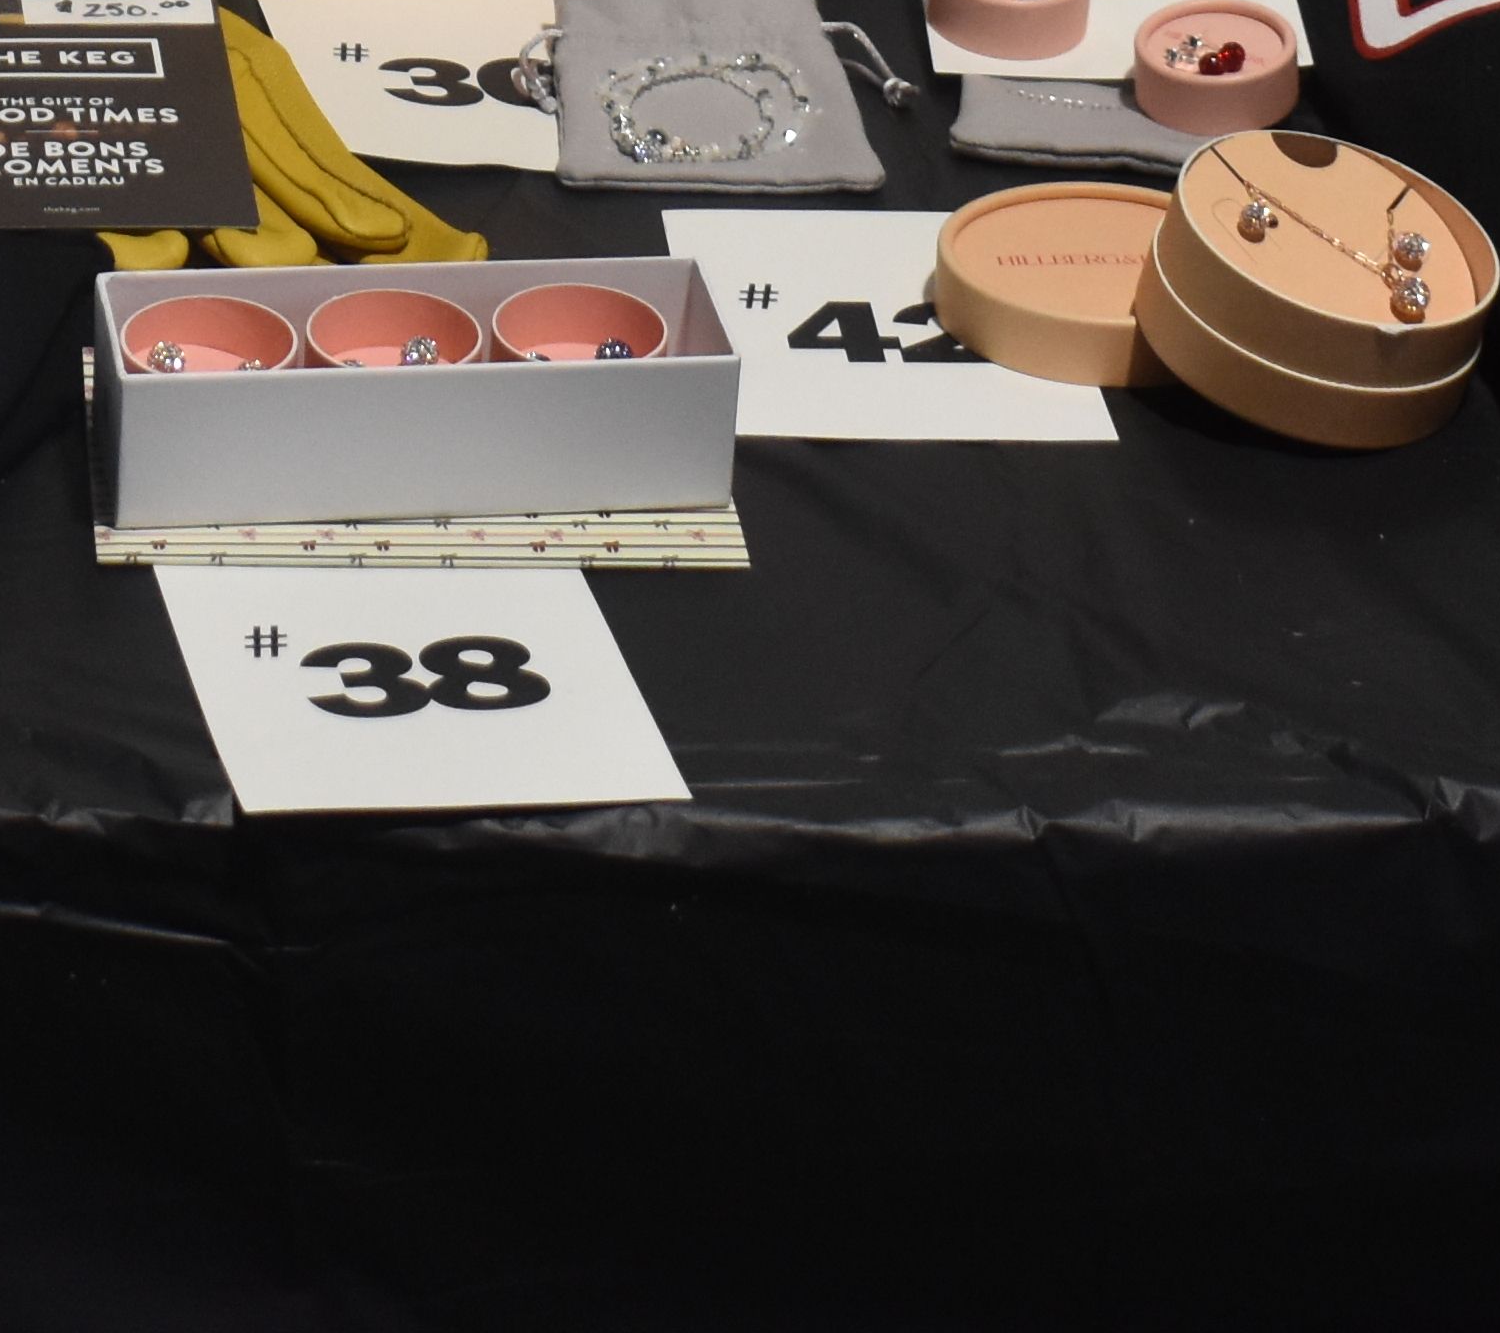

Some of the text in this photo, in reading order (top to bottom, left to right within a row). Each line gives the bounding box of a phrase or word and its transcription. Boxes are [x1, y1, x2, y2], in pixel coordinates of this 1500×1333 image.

[59, 50, 136, 65] KEG
[0, 96, 115, 107] THE GIFT OF
[66, 107, 180, 124] TIMES
[44, 141, 150, 158] BONS
[13, 176, 126, 187] EN CADEAU
[997, 252, 1148, 269] HILLBERG&
[244, 624, 552, 720] #38
